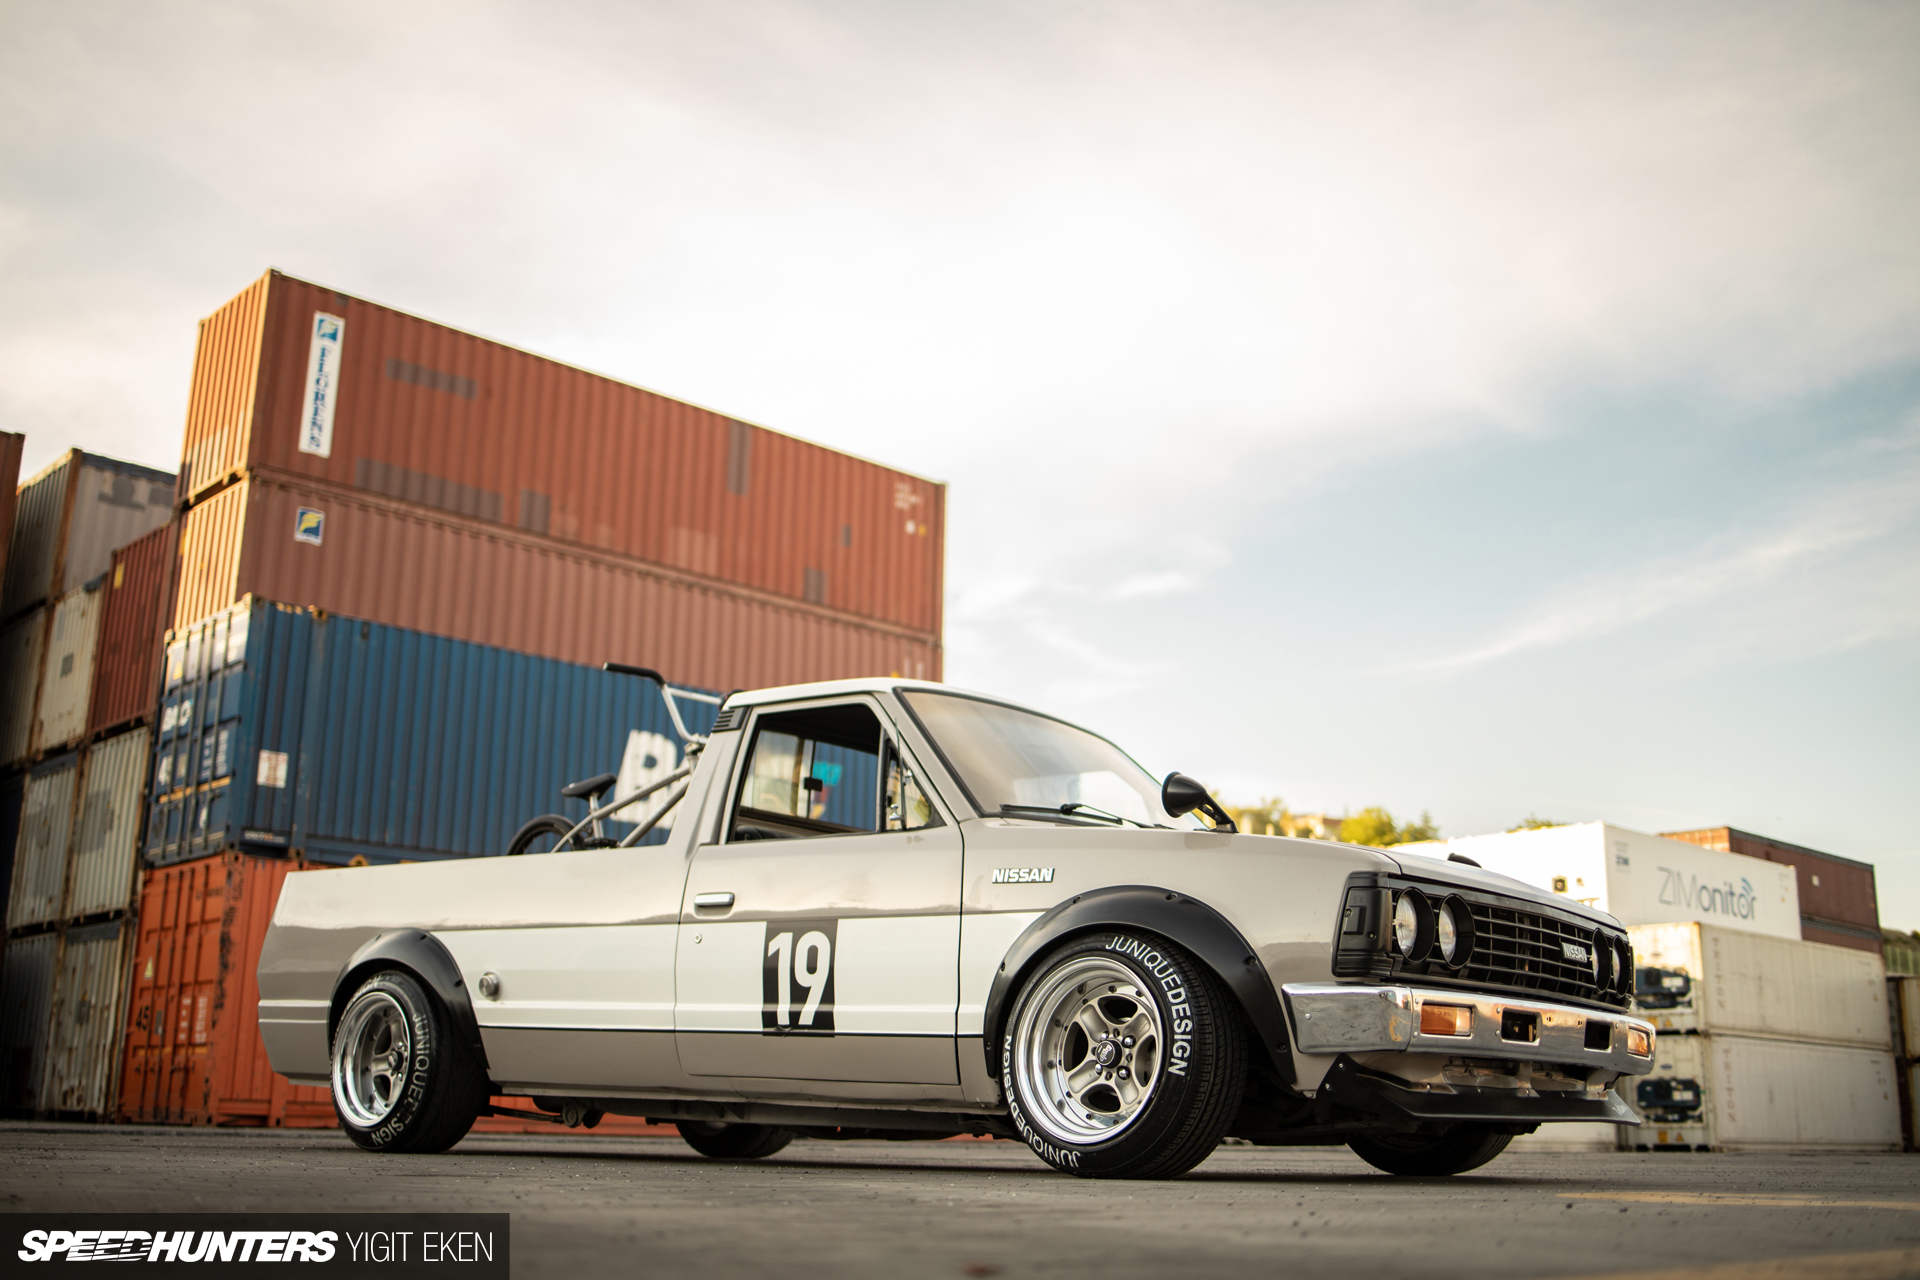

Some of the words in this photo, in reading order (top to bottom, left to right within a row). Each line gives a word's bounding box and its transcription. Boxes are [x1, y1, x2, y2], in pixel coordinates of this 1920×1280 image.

[991, 867, 1055, 884] NISSAN
[1657, 866, 1756, 920] ZIMonitor
[767, 930, 831, 1026] 19
[1562, 942, 1588, 962] NISSAN
[1105, 936, 1193, 1077] JUNIQUEDESIGN
[370, 1013, 430, 1147] JUNIQUESIGN
